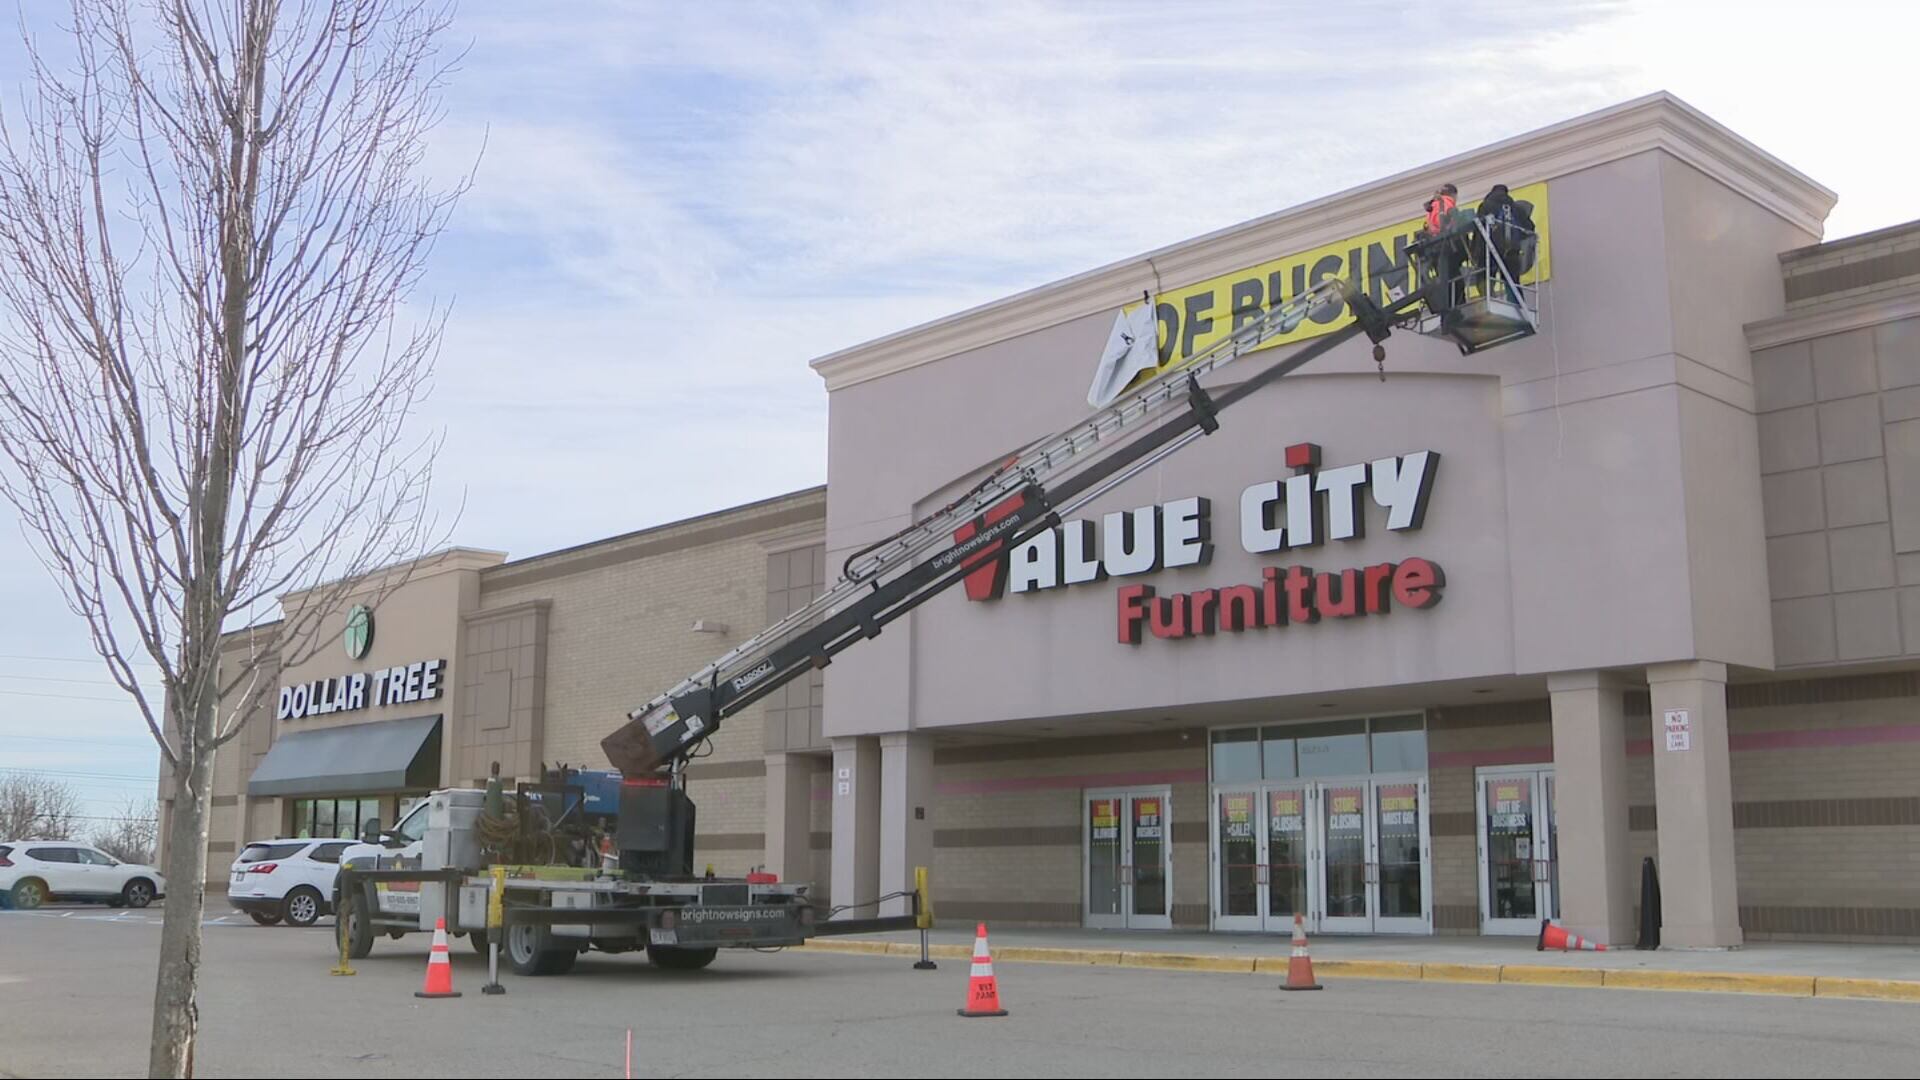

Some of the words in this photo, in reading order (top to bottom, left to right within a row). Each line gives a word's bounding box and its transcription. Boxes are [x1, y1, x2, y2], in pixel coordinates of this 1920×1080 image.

[1156, 290, 1214, 367] OF
[932, 514, 1020, 569] brightnowsigns.com
[1117, 557, 1443, 643] Furniture
[277, 671, 368, 720] DOLLAR
[373, 659, 444, 707] TREE
[681, 908, 785, 923] brightnowsigns.com
